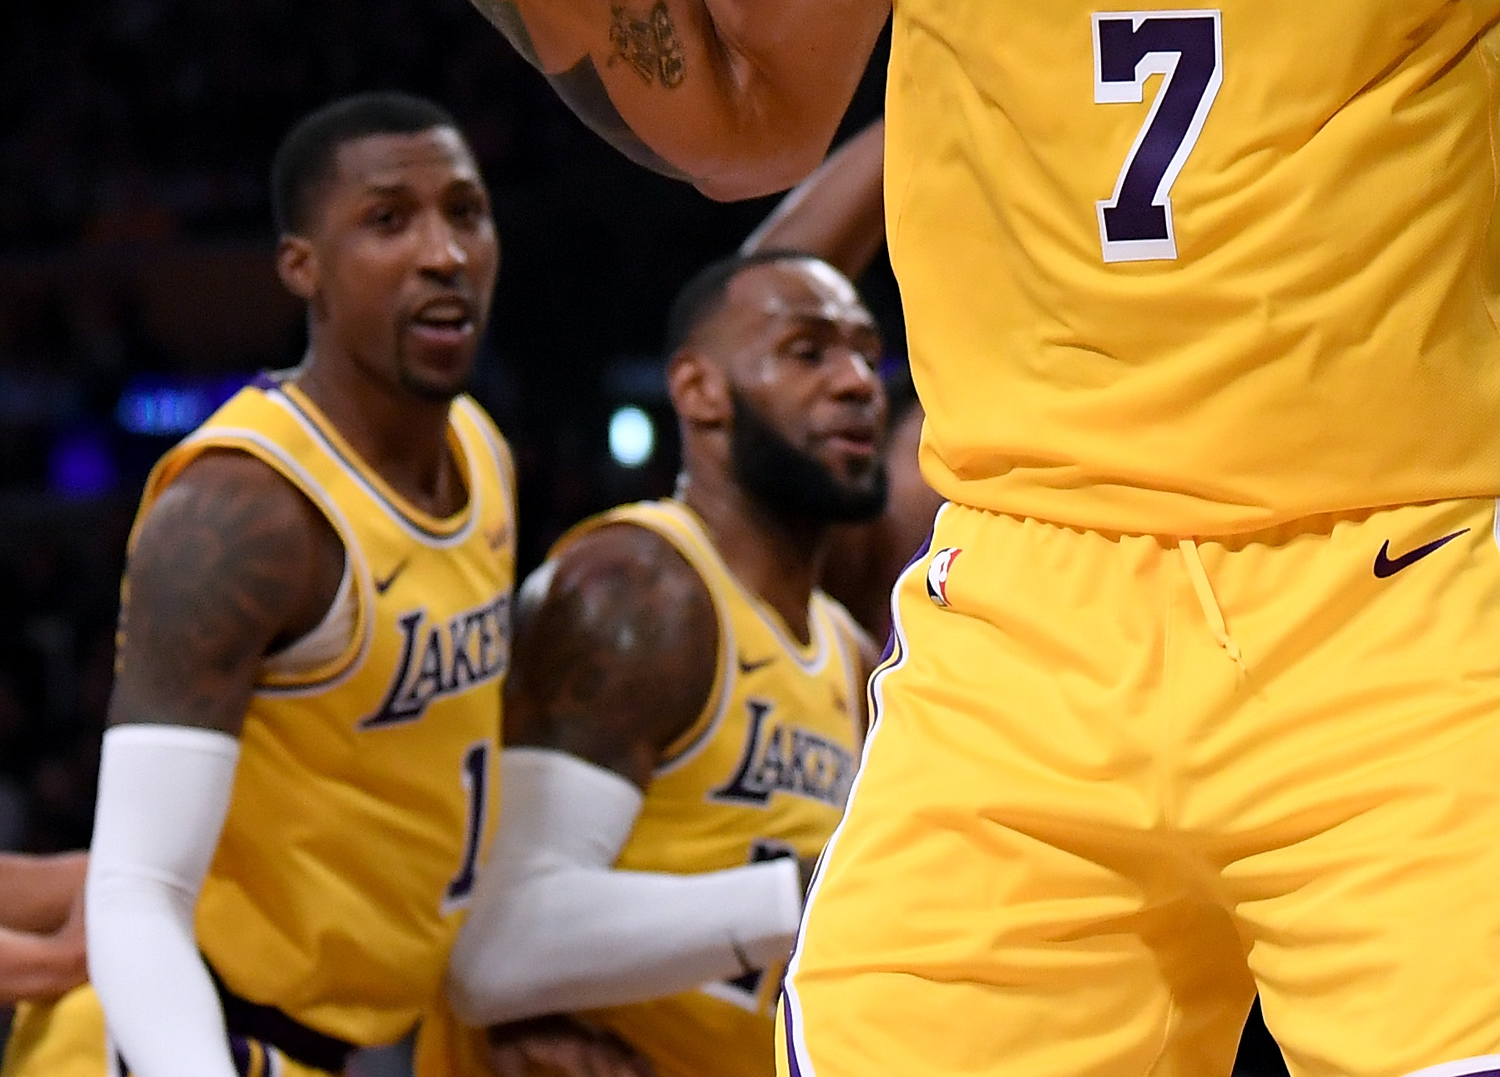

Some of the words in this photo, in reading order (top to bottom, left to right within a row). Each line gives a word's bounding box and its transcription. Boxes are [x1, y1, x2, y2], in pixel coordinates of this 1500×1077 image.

[1091, 9, 1223, 263] 7
[357, 589, 508, 731] LAKE
[440, 739, 492, 918] 1
